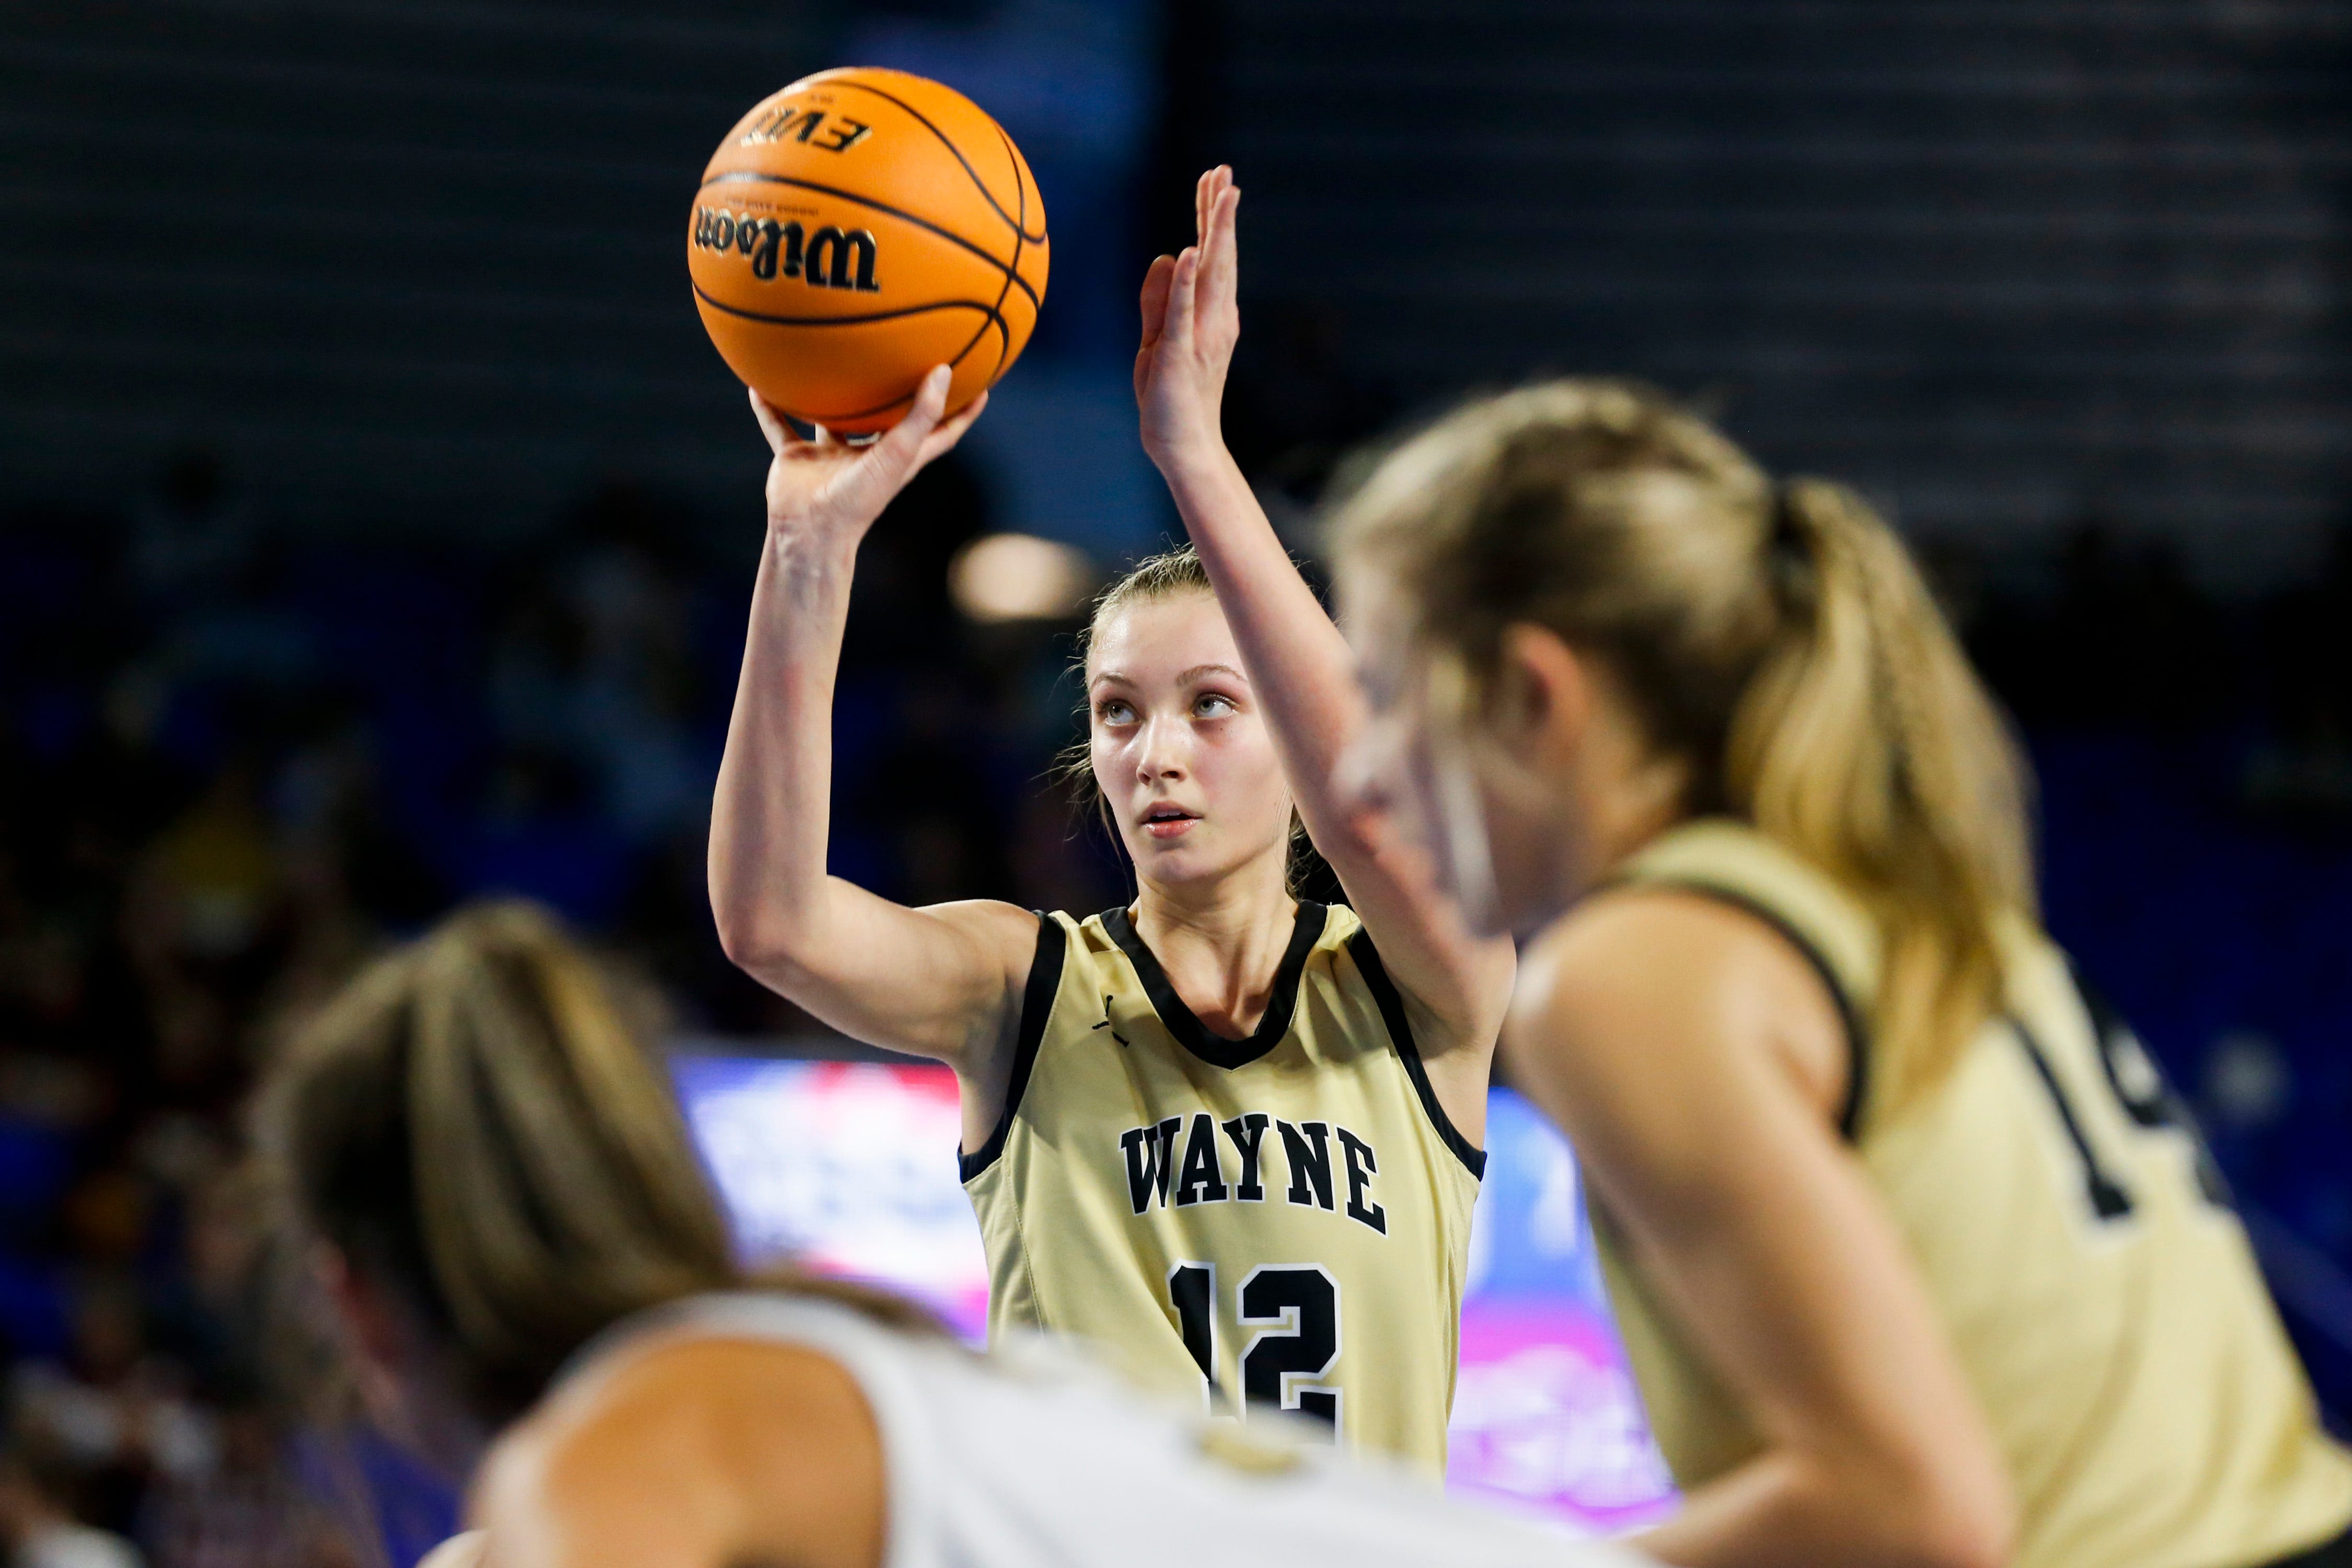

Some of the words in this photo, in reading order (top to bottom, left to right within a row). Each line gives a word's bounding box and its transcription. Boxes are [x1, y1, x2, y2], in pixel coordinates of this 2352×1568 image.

[694, 204, 881, 293] Wilson
[1119, 1112, 1388, 1238] WAYNE
[1166, 1257, 1343, 1448] 12
